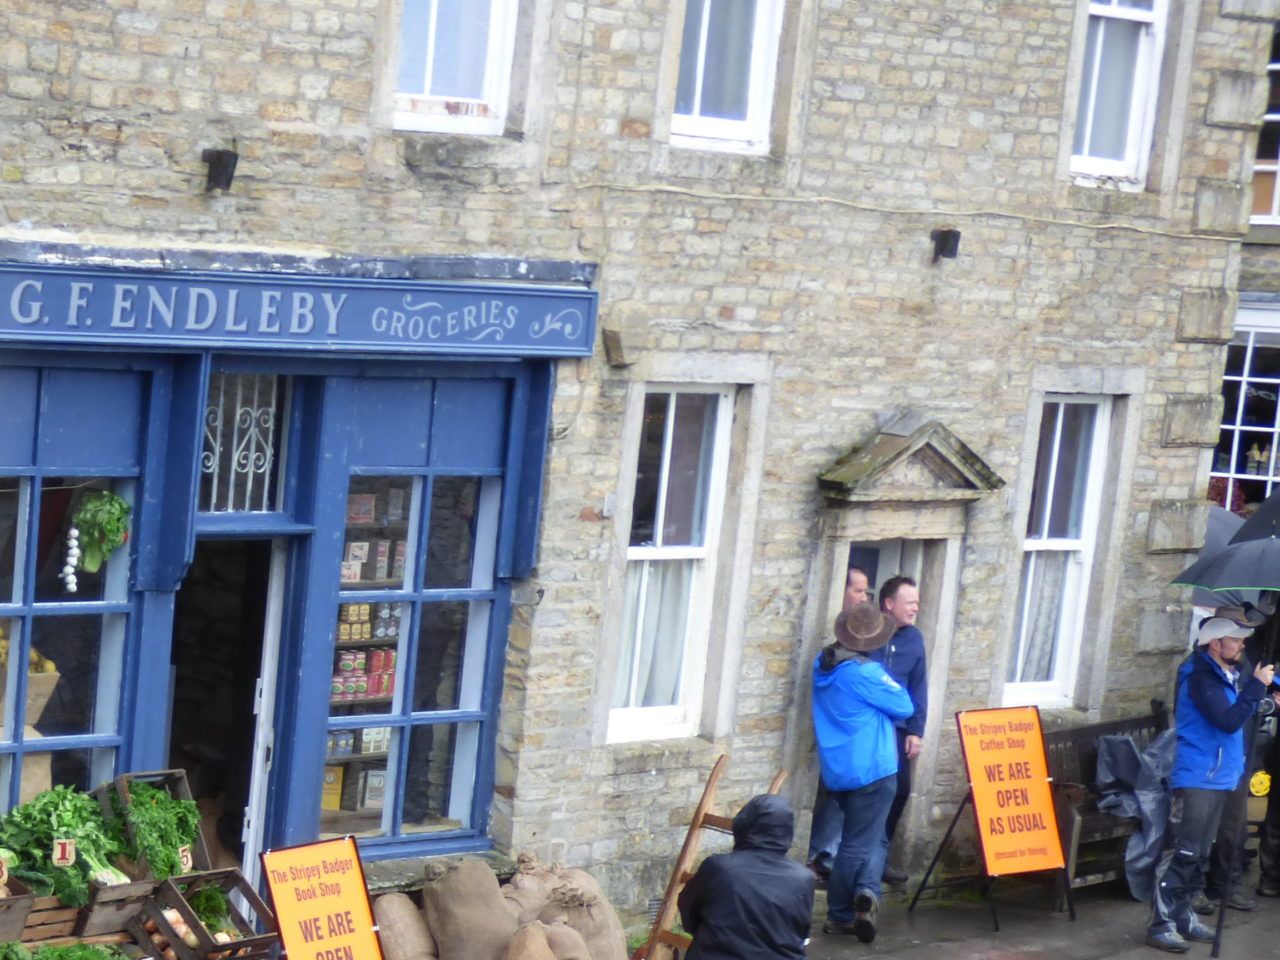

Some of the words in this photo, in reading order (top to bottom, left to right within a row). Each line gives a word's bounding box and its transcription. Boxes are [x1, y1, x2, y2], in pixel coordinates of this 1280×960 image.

[111, 284, 348, 335] ENDLEBY
[372, 300, 518, 340] GROCERIES
[963, 724, 978, 736] The
[1007, 737, 1026, 751] Shop
[984, 763, 1005, 783] WE
[1008, 761, 1032, 781] ARE
[996, 787, 1030, 809] OPEN
[989, 816, 1005, 836] AS
[1007, 812, 1047, 833] USUAL
[270, 869, 289, 885] The
[289, 864, 321, 881] Stripey
[322, 857, 353, 875] Badger
[294, 885, 318, 902] Book
[319, 881, 342, 898] Shop
[298, 917, 324, 943] WE
[327, 911, 356, 938] ARE
